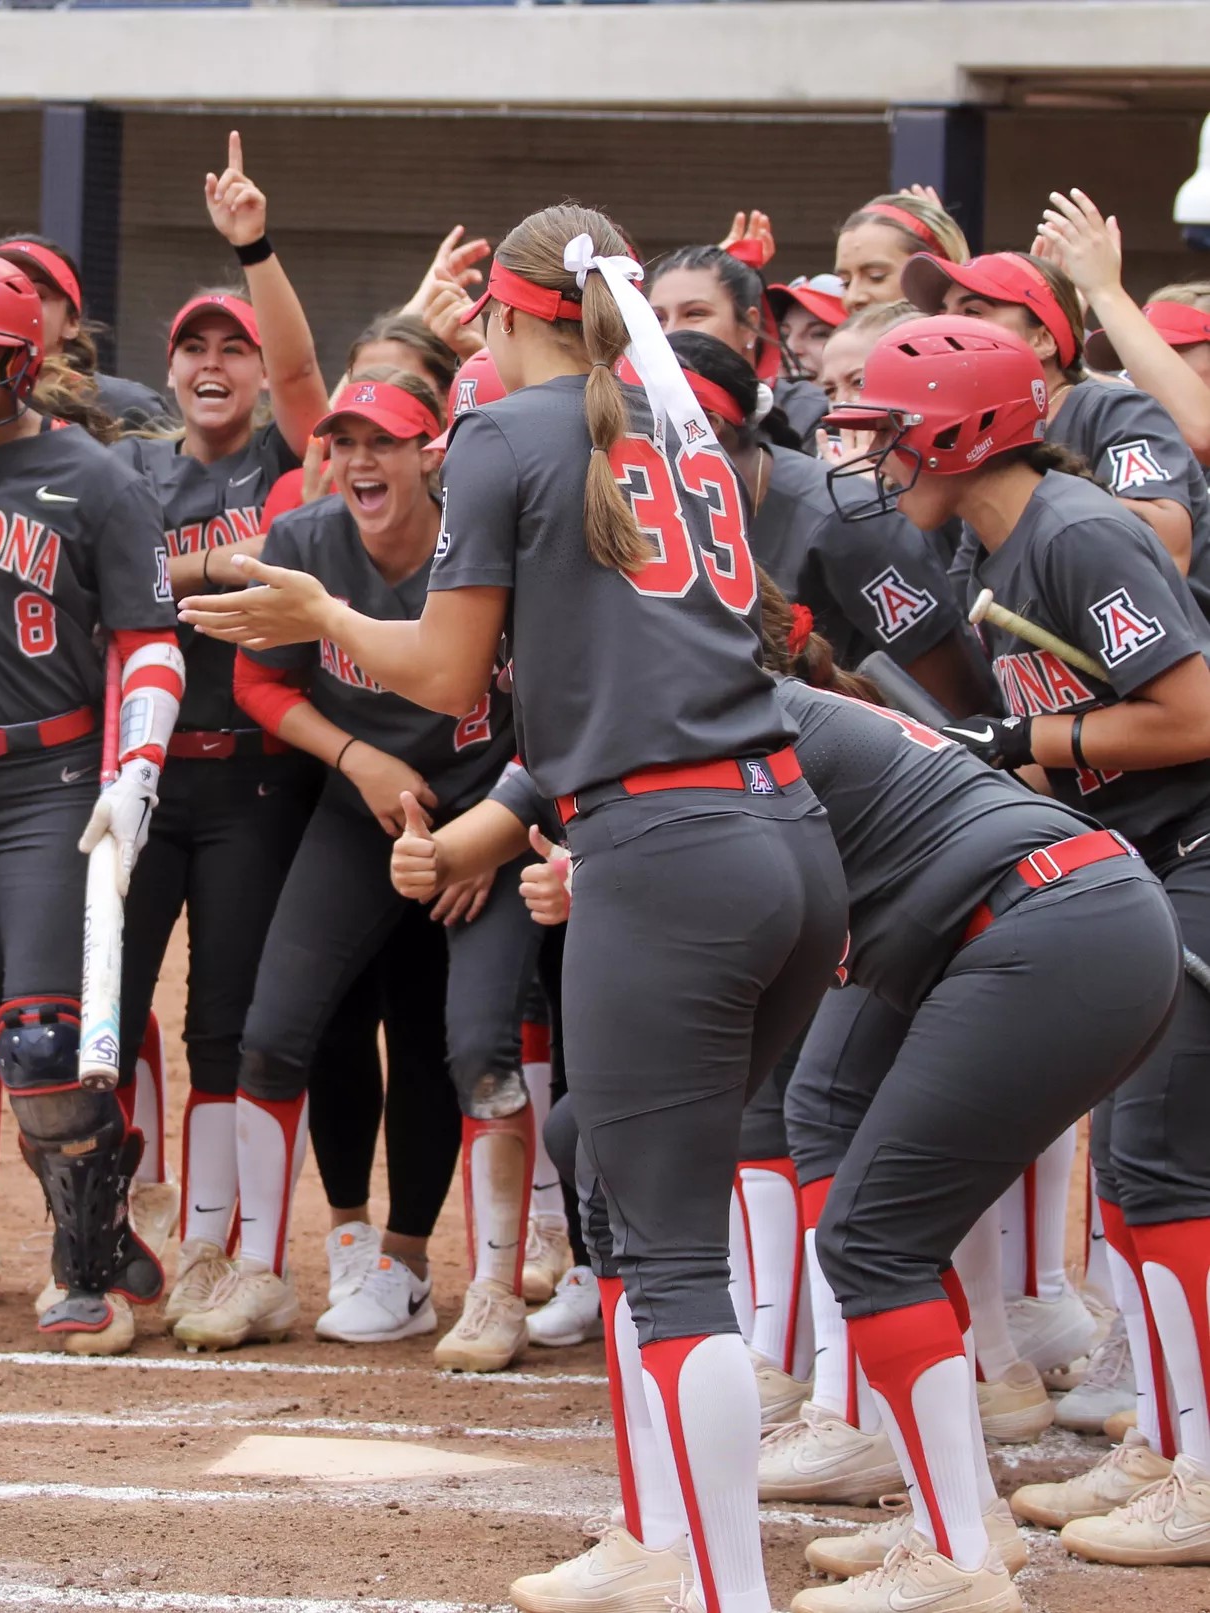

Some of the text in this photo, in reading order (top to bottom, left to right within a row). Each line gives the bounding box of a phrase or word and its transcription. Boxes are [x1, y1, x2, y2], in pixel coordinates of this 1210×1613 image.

[683, 419, 707, 444] A
[1107, 439, 1172, 493] A
[13, 590, 58, 658] 8
[861, 565, 939, 644] A
[1088, 586, 1167, 669] A
[747, 761, 775, 795] A
